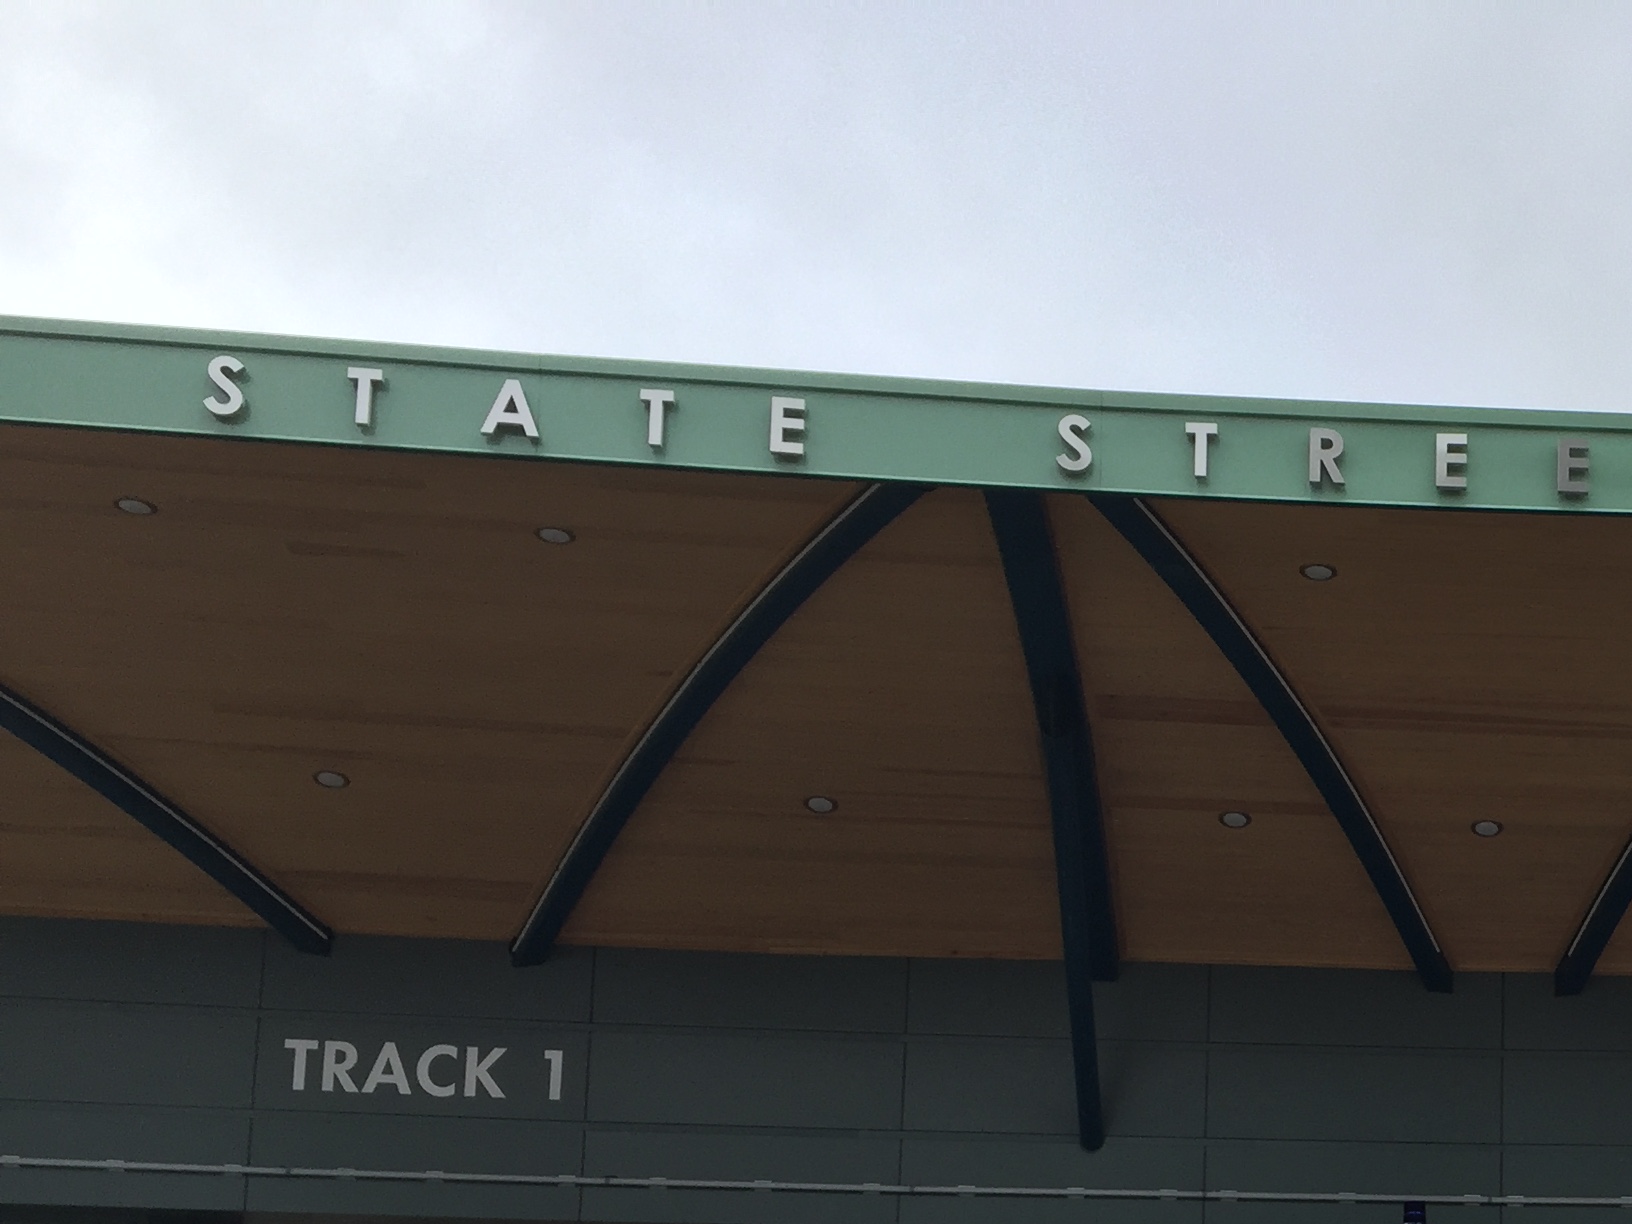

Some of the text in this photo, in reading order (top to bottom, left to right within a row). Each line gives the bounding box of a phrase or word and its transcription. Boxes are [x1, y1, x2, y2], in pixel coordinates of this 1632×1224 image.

[203, 354, 809, 459] STATE
[284, 1038, 564, 1100] TRACK 1
